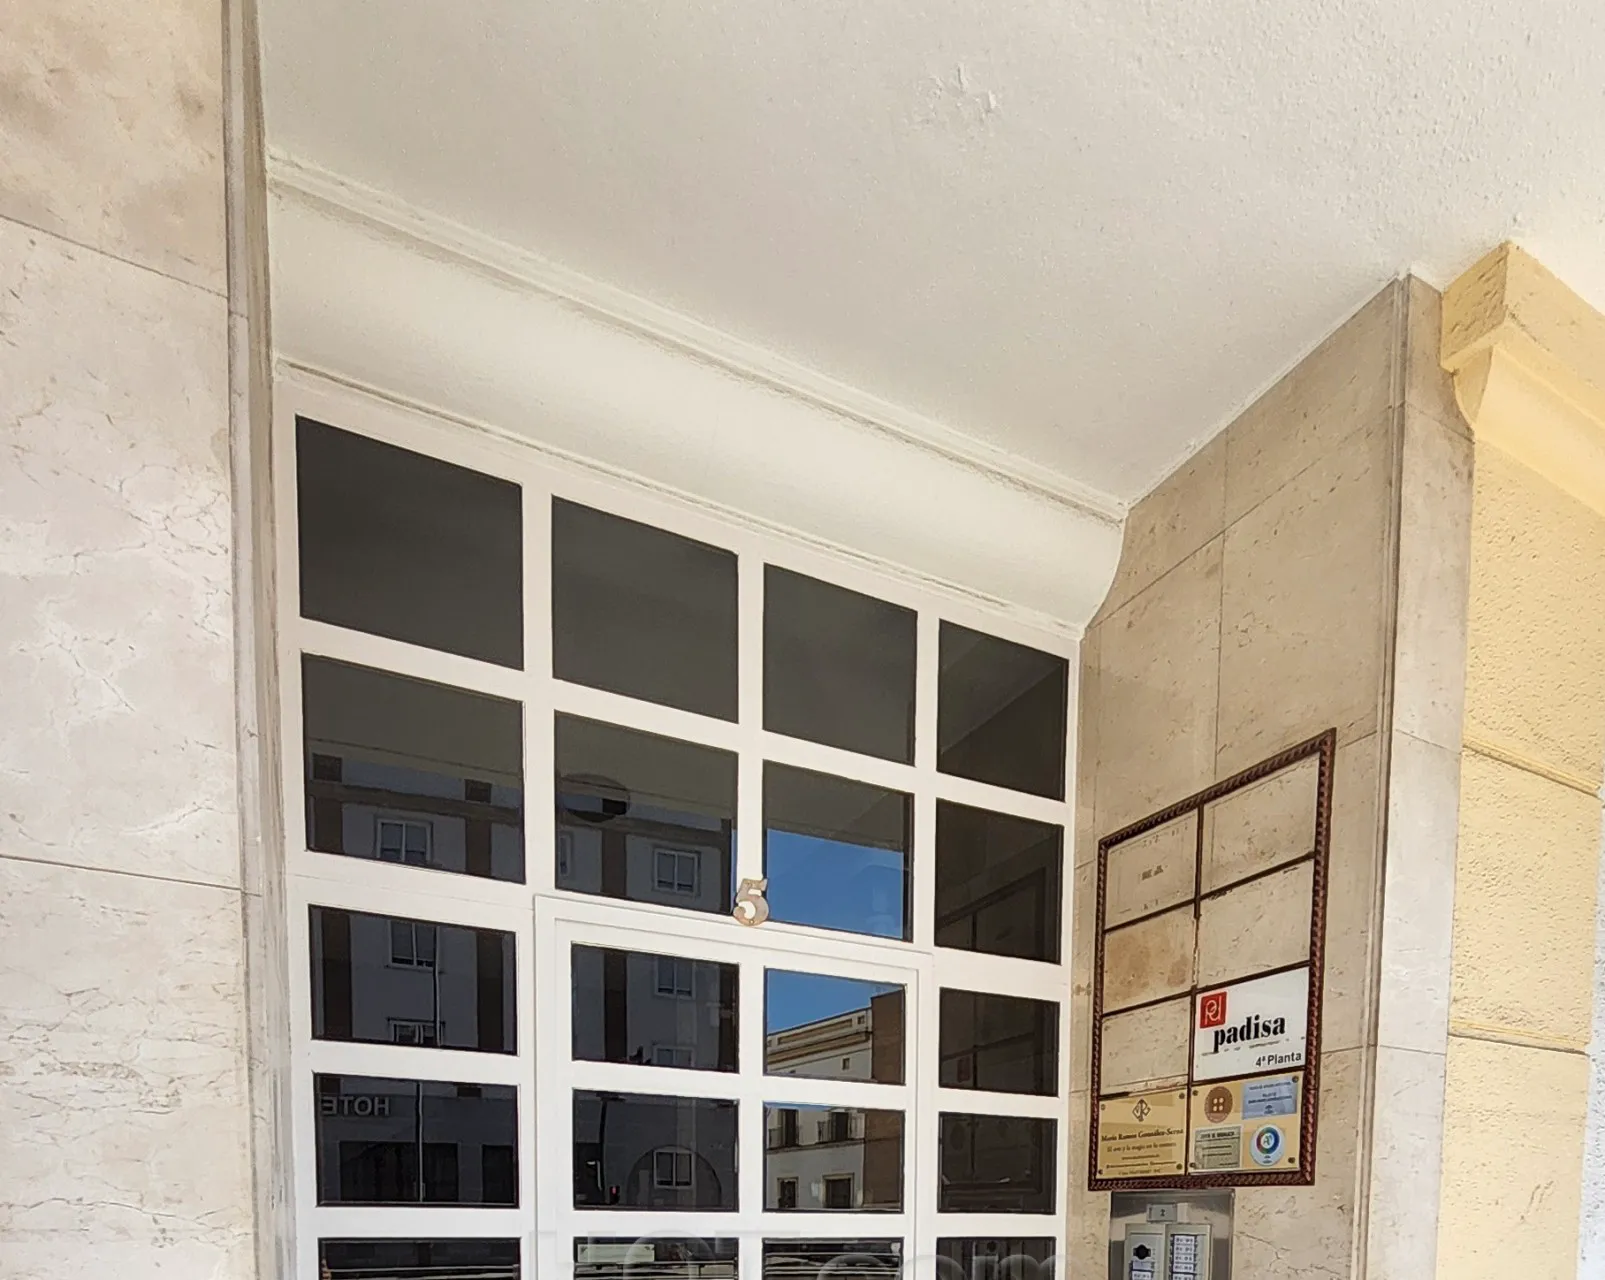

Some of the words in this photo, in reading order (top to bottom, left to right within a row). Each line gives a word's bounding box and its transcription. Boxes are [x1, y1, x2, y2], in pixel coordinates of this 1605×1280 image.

[733, 878, 769, 926] 5
[1213, 1014, 1286, 1053] padisa
[1267, 1051, 1302, 1066] Planta
